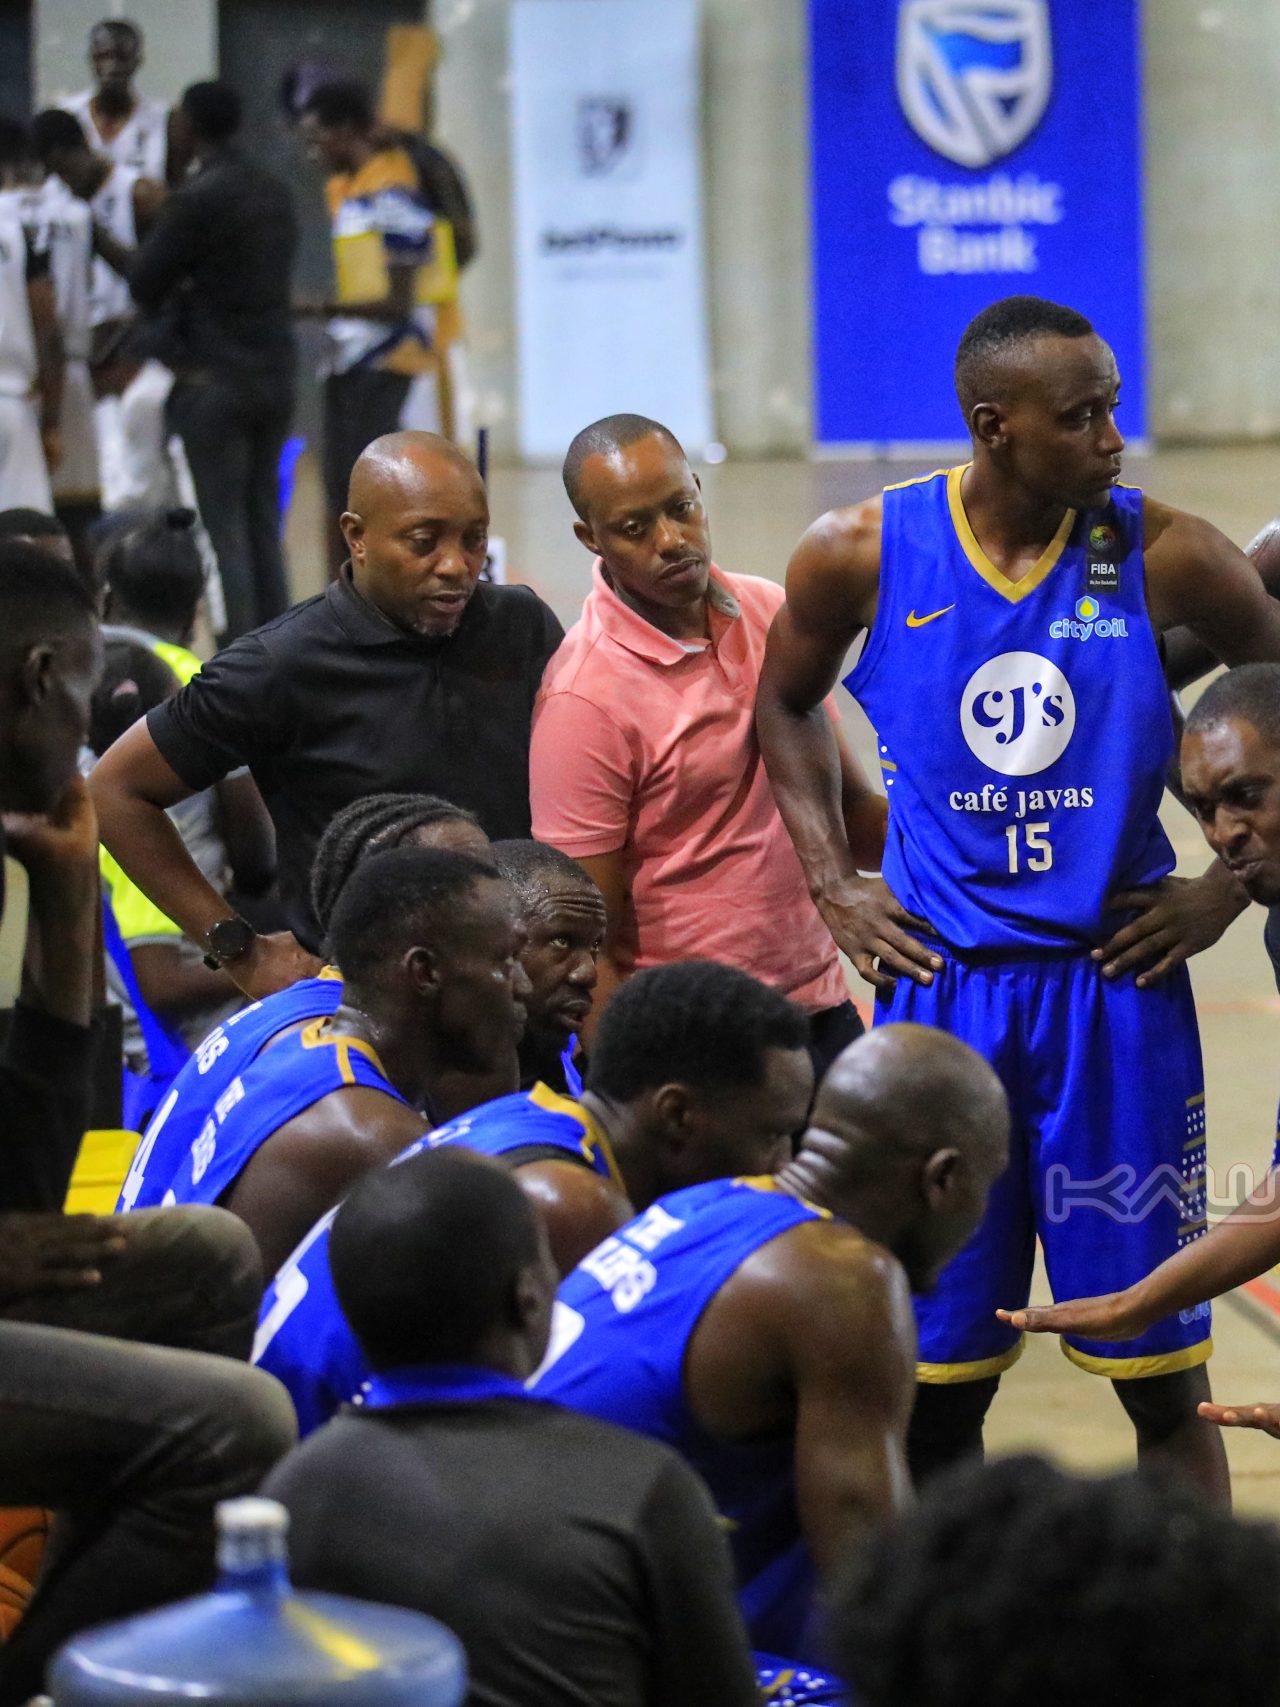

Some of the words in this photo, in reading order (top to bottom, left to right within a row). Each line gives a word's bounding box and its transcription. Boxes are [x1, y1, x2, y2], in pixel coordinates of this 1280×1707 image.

[888, 174, 1061, 227] Stanbic
[918, 226, 1038, 274] Bank
[1091, 563, 1116, 575] FIBA
[949, 784, 1008, 812] café
[1015, 787, 1094, 818] javas
[1005, 822, 1052, 873] 15
